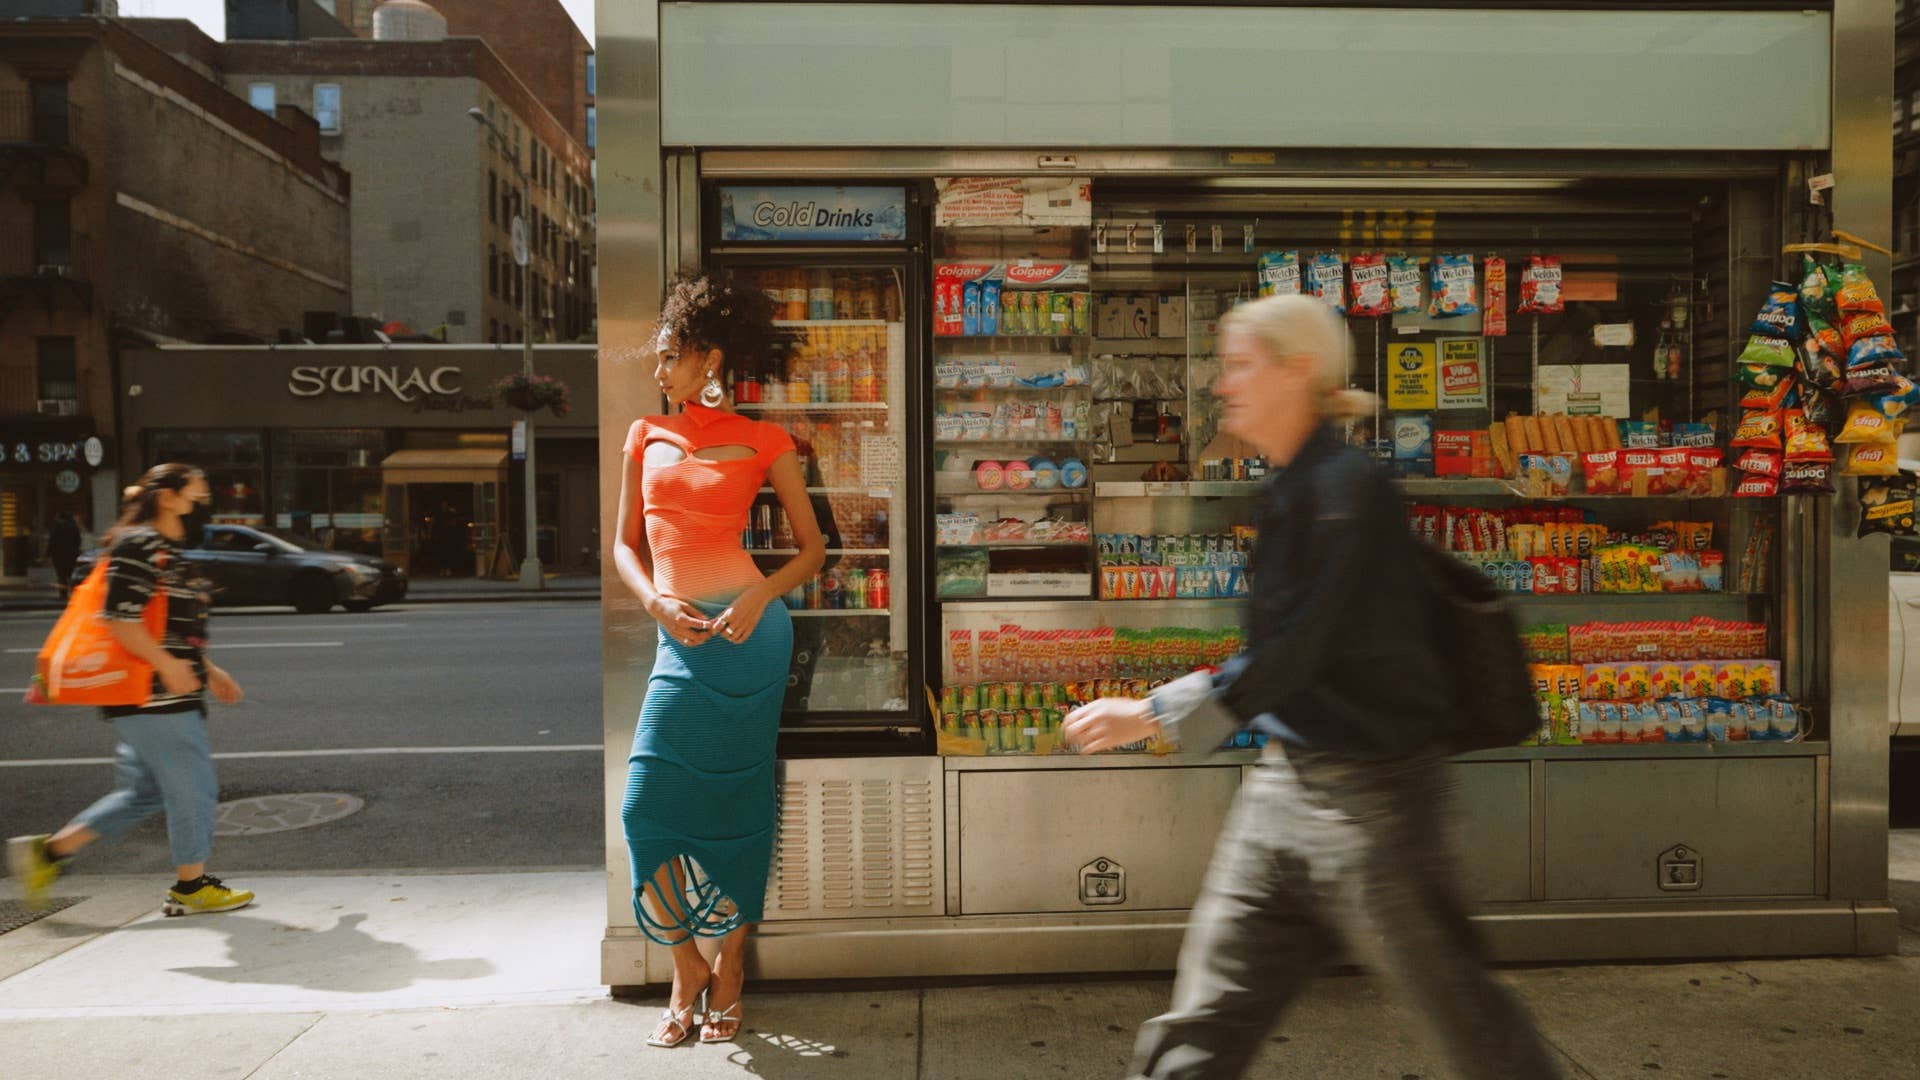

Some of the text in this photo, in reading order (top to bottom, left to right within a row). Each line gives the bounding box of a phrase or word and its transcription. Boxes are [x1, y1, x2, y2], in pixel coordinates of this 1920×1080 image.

[753, 201, 873, 227] Cold Drinks
[938, 265, 982, 277] Colgate
[1010, 265, 1055, 277] Colgate
[1268, 265, 1300, 280] Welch's
[1354, 266, 1386, 280] Welch's
[1442, 268, 1472, 280] Welch's
[1756, 312, 1796, 326] Doritos
[1449, 365, 1472, 376] We
[1846, 367, 1889, 379] Doritos
[288, 366, 462, 402] SUNAC
[1445, 373, 1477, 387] Card
[1854, 417, 1882, 428] Lay's
[1437, 434, 1471, 442] TYLENOL
[1683, 436, 1715, 447] Welch's
[15, 443, 30, 462] &
[39, 443, 77, 462] SPA
[1855, 450, 1883, 462] Lay's
[1785, 468, 1826, 479] Doritos
